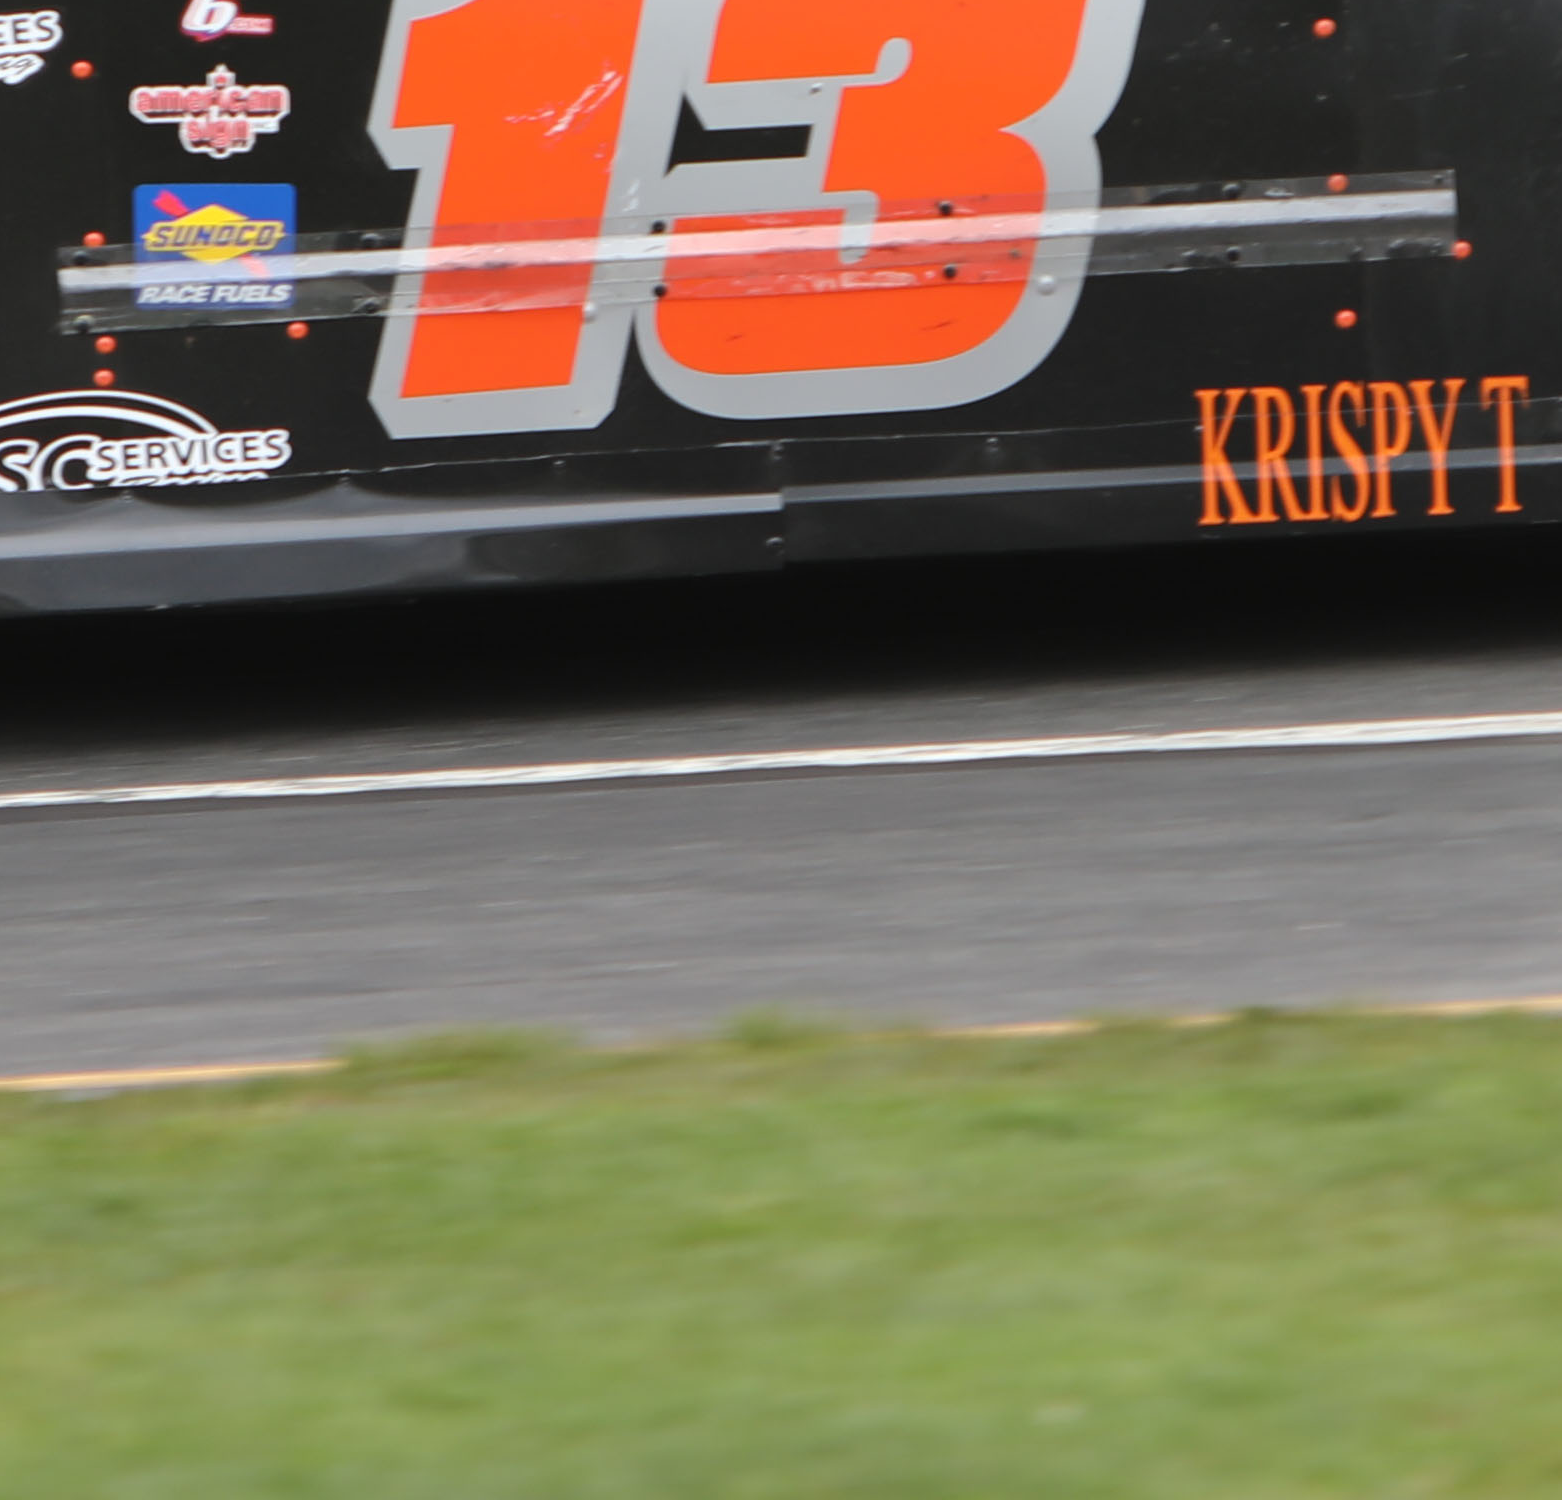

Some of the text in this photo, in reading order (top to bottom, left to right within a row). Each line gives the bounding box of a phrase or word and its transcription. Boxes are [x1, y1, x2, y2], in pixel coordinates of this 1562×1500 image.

[151, 224, 276, 248] SUNOCO
[136, 282, 294, 304] RACE FUELS
[91, 431, 289, 476] SERVICES
[1194, 375, 1530, 526] KRISPY T
